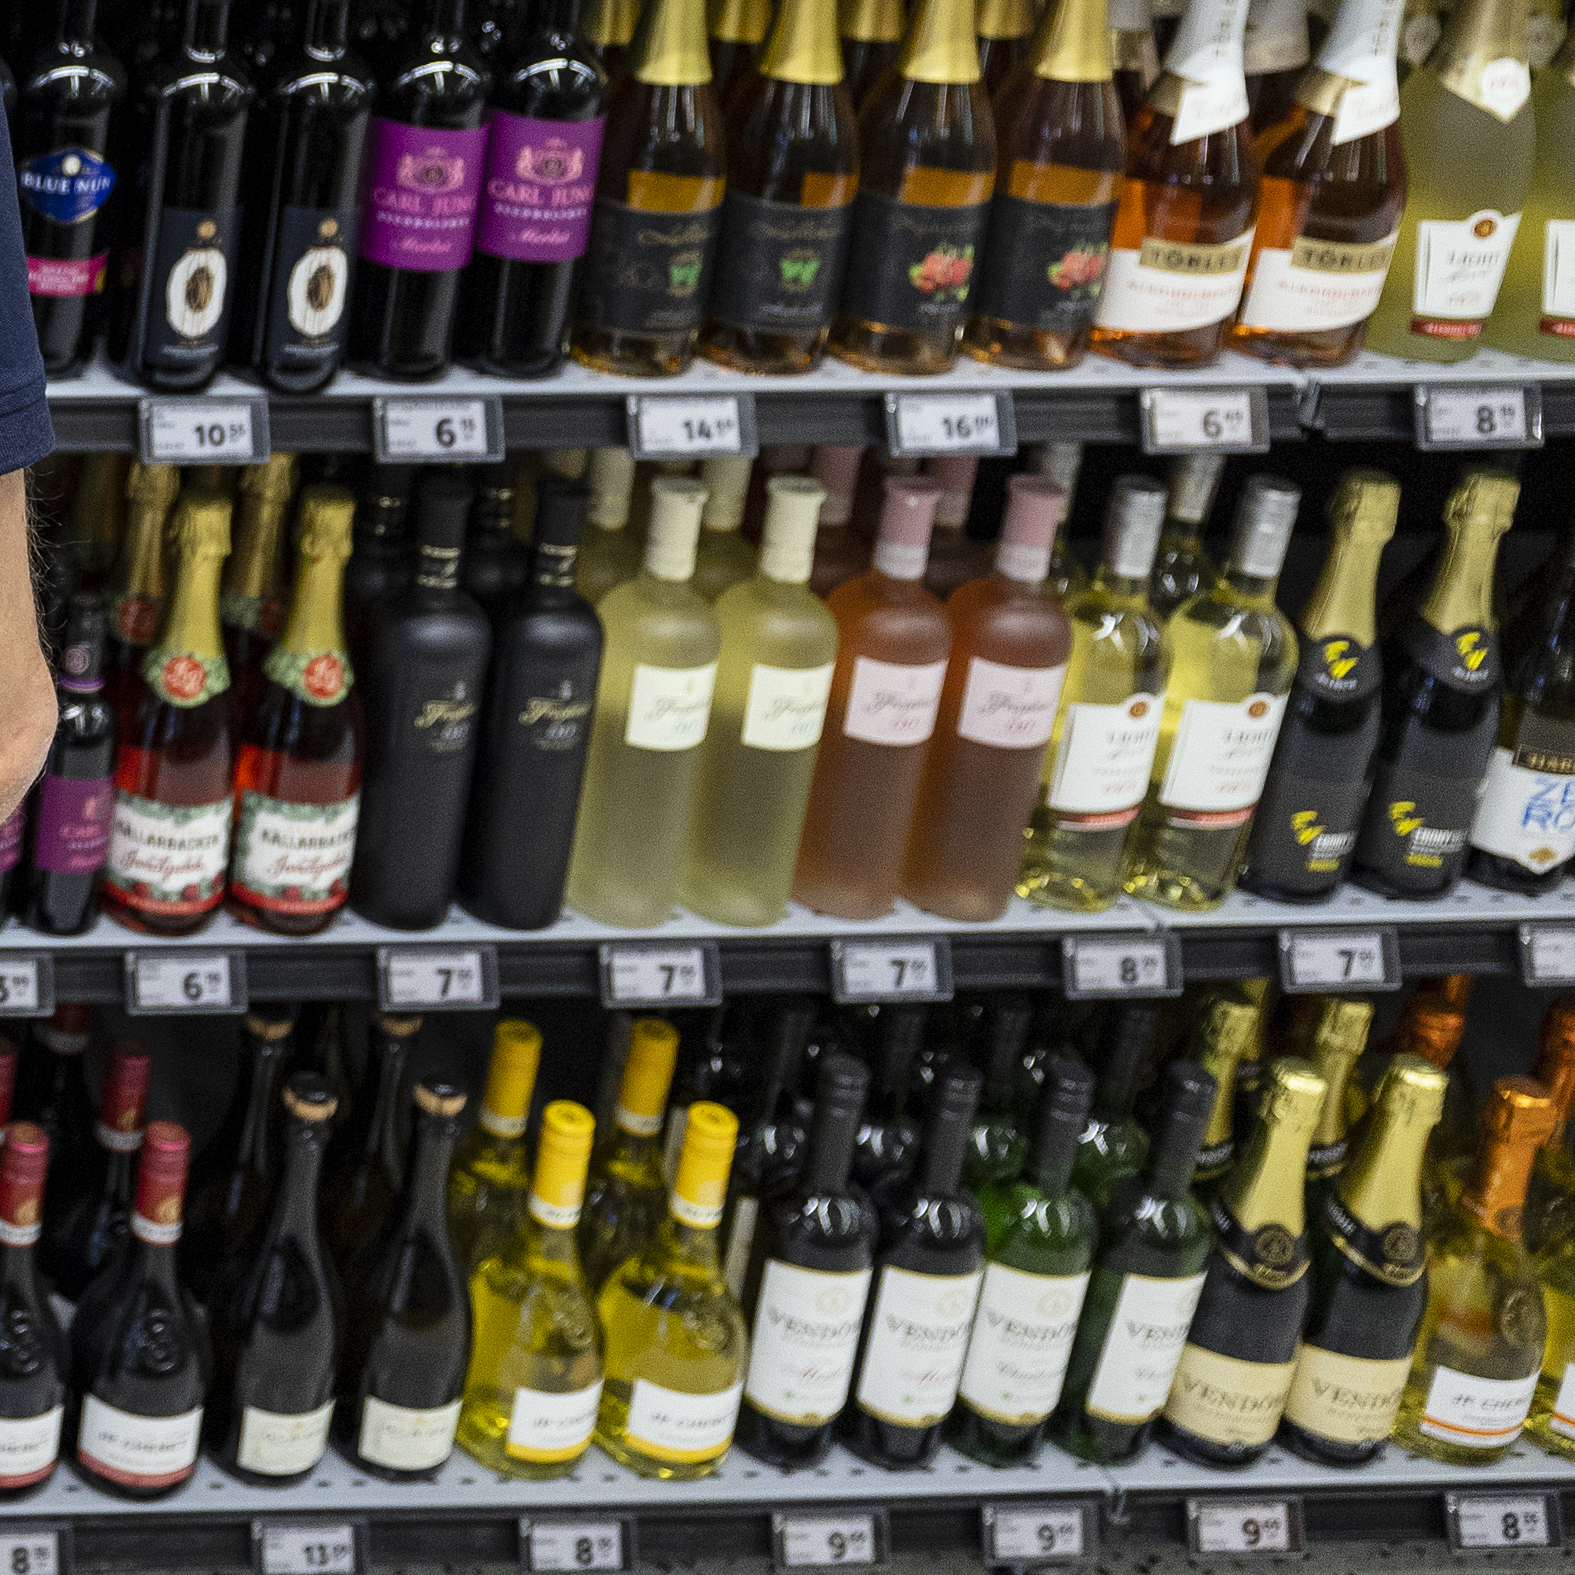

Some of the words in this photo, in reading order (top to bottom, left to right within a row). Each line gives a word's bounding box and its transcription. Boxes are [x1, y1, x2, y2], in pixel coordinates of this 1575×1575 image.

[22, 172, 68, 195] BLUE
[75, 173, 111, 193] NUN
[435, 418, 457, 447] 6
[1202, 410, 1223, 438] 6
[1475, 405, 1497, 434] 8
[194, 423, 225, 446] 10
[889, 960, 908, 988] 7
[1119, 956, 1139, 984] 8
[1337, 950, 1358, 977] 7
[183, 972, 202, 1001] 6
[435, 969, 453, 997] 7
[659, 964, 677, 992] 7
[1037, 1524, 1056, 1552] 9
[1242, 1518, 1261, 1545] 9
[1502, 1512, 1521, 1540] 8
[575, 1537, 593, 1565] 8
[827, 1531, 846, 1559] 9
